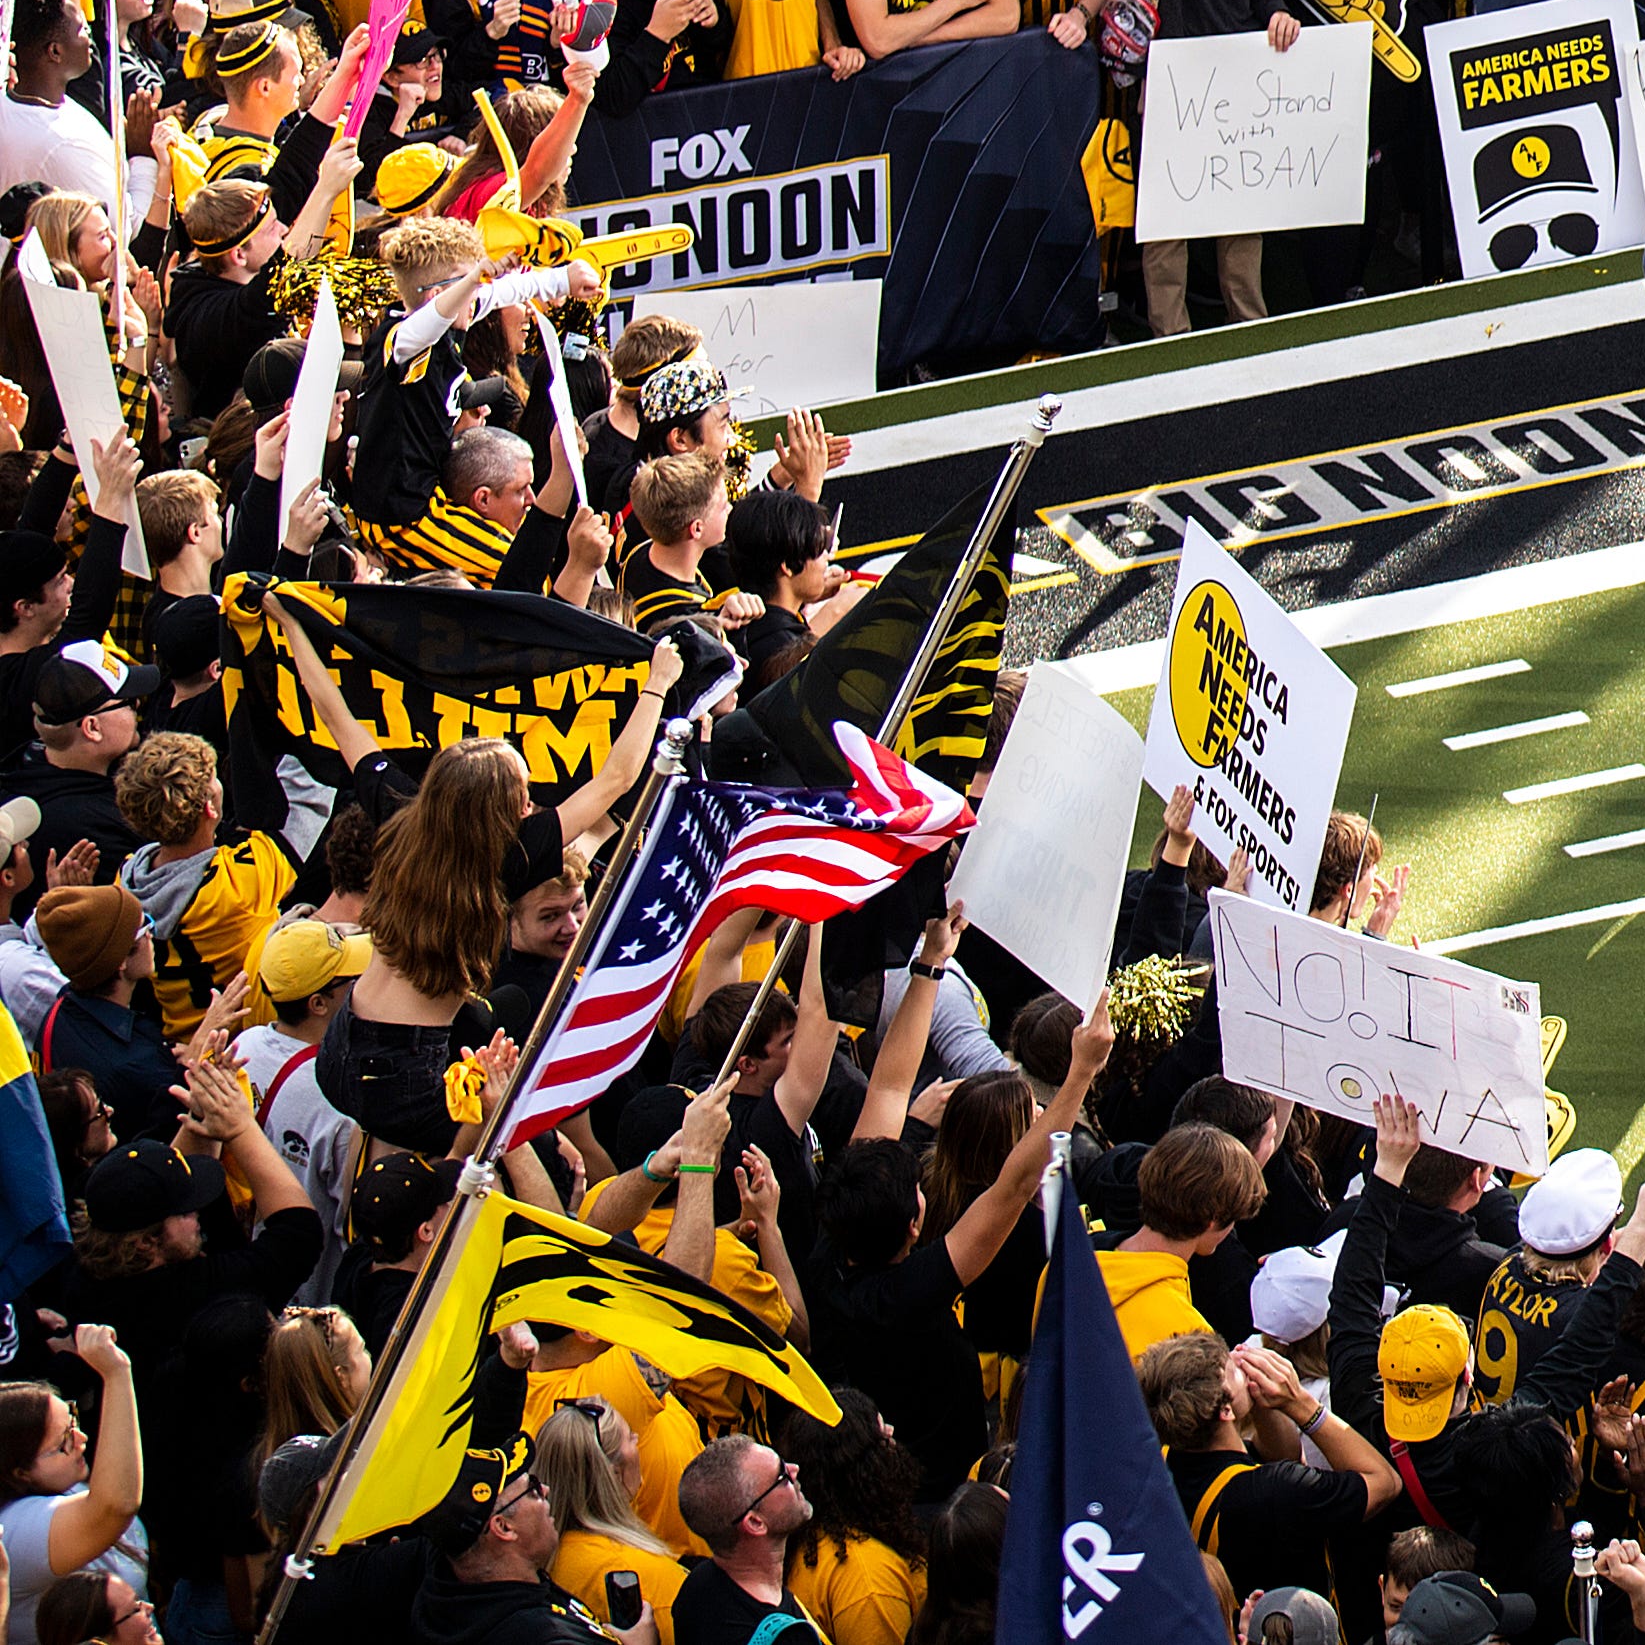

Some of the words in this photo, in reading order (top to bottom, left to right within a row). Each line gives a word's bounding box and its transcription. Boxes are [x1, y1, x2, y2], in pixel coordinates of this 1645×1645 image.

[1461, 50, 1544, 81] AMERICA
[1547, 35, 1603, 64] NEEDS
[1462, 54, 1611, 110] FARMERS
[1168, 63, 1231, 132] We
[1250, 69, 1334, 119] Stand
[652, 124, 752, 187] FOX
[1165, 134, 1338, 202] URBAN
[1217, 122, 1275, 146] with
[672, 166, 869, 277] NOON
[1068, 474, 1306, 562] BIG
[1194, 591, 1288, 727] AMERICA
[1199, 662, 1268, 759] NEEDS
[1203, 715, 1298, 848] FARMERS
[1192, 774, 1206, 803] &
[1205, 792, 1239, 842] FOX
[1237, 824, 1302, 913] SPORTS!
[1487, 1264, 1559, 1330] AYLOR
